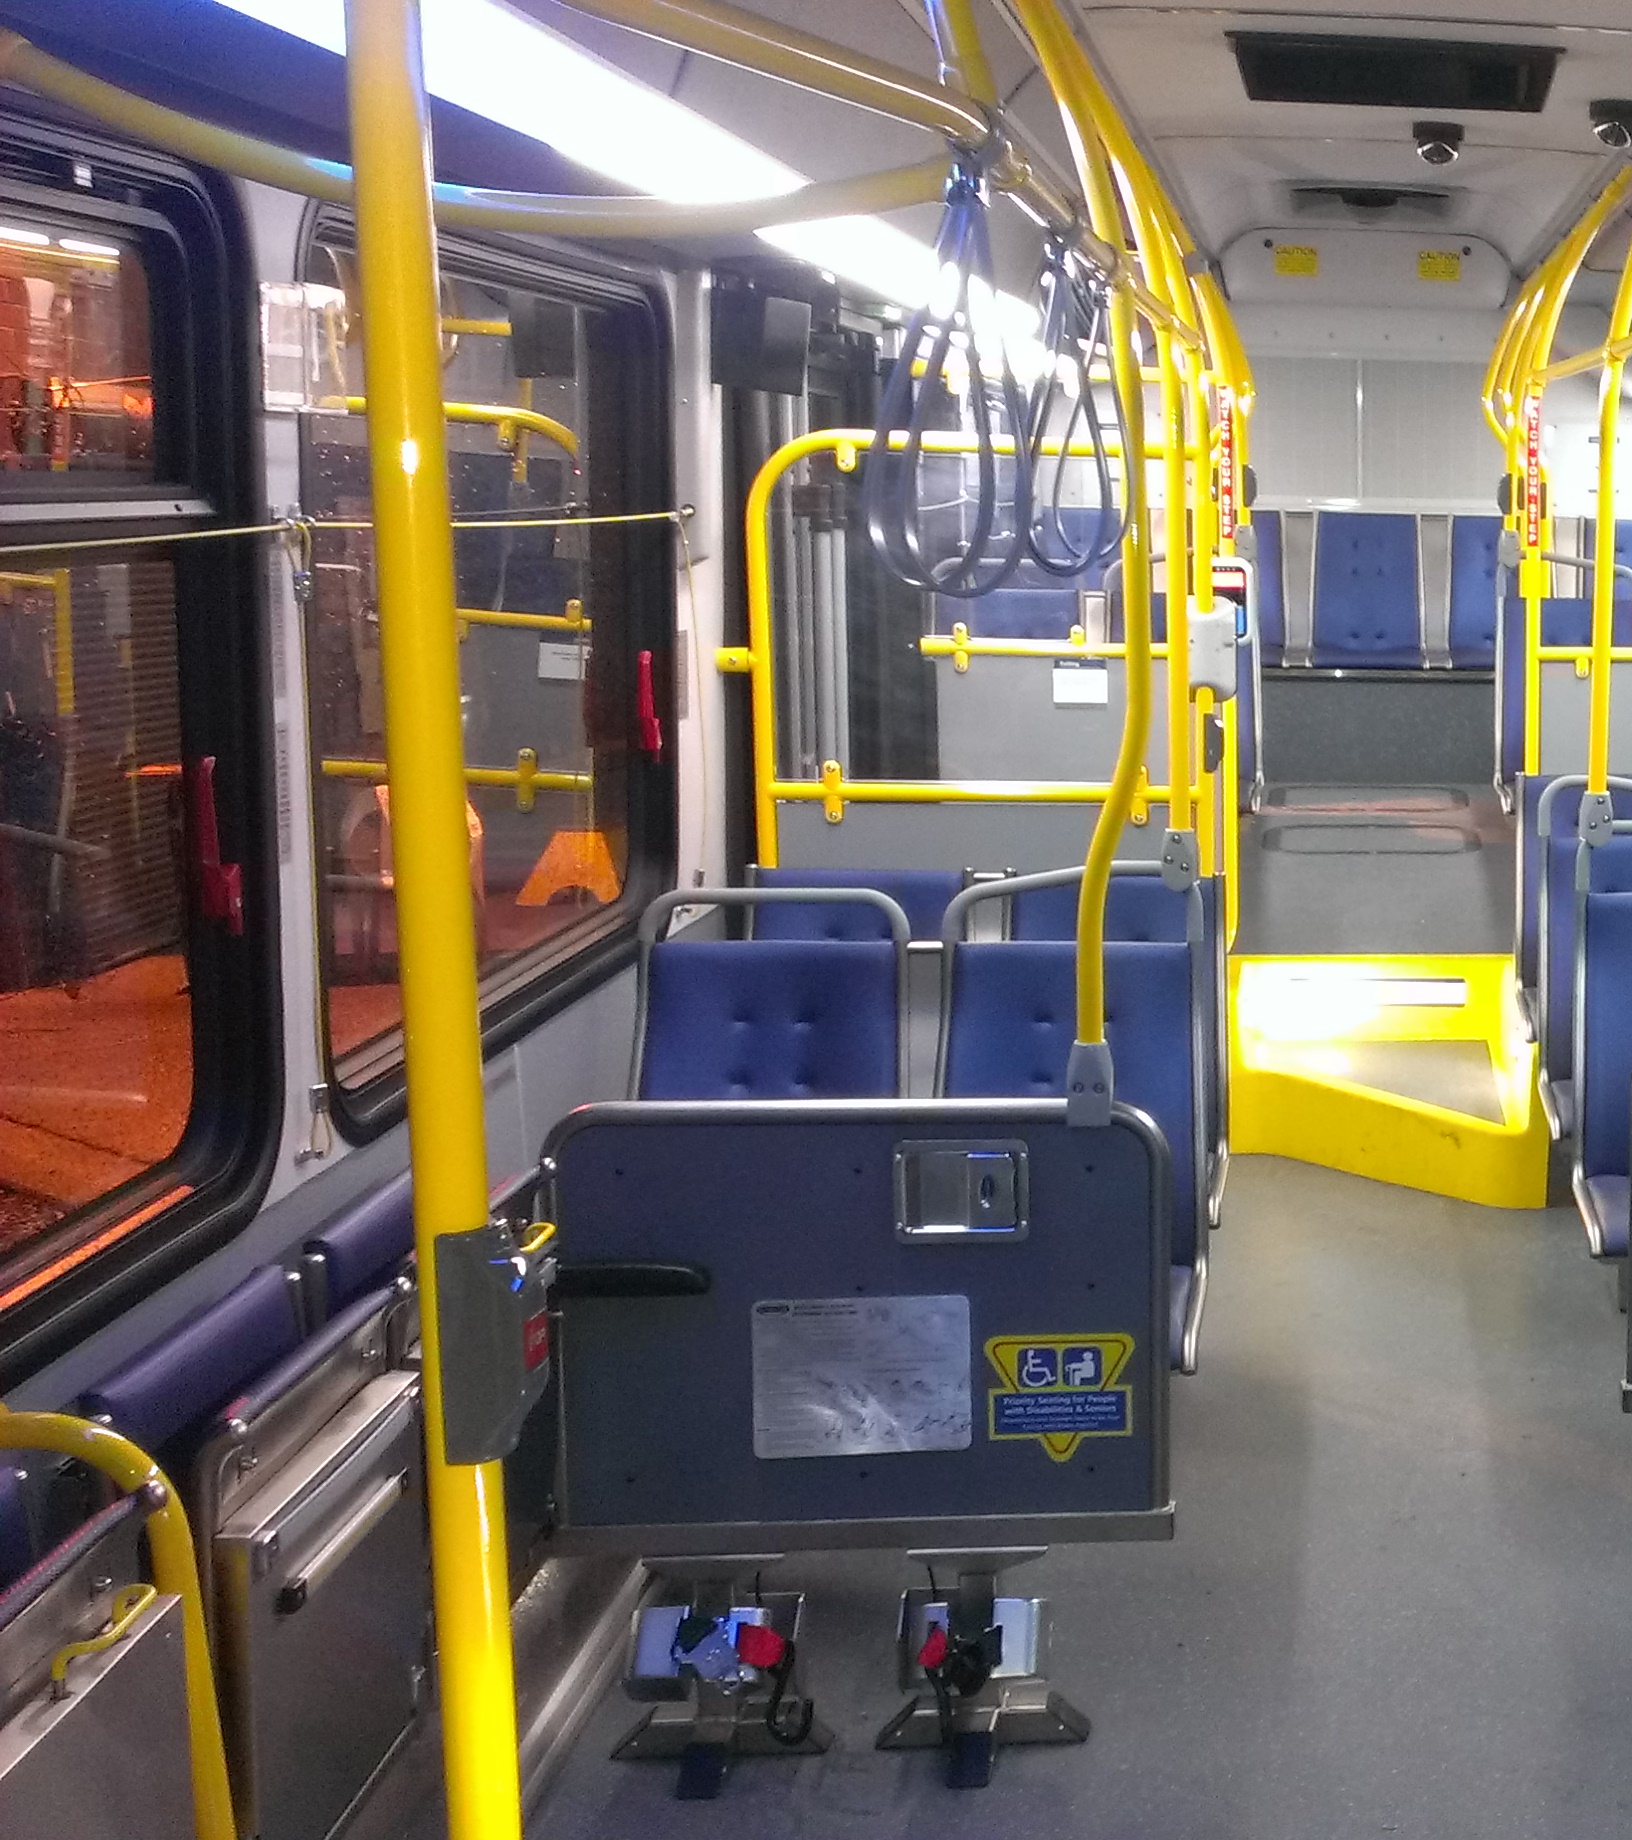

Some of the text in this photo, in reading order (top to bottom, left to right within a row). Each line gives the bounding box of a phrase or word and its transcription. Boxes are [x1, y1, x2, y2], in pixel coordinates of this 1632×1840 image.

[1221, 447, 1231, 486] YOUR
[1529, 457, 1538, 495] YOUR
[1222, 495, 1232, 536] STEP
[1528, 504, 1538, 543] STEP
